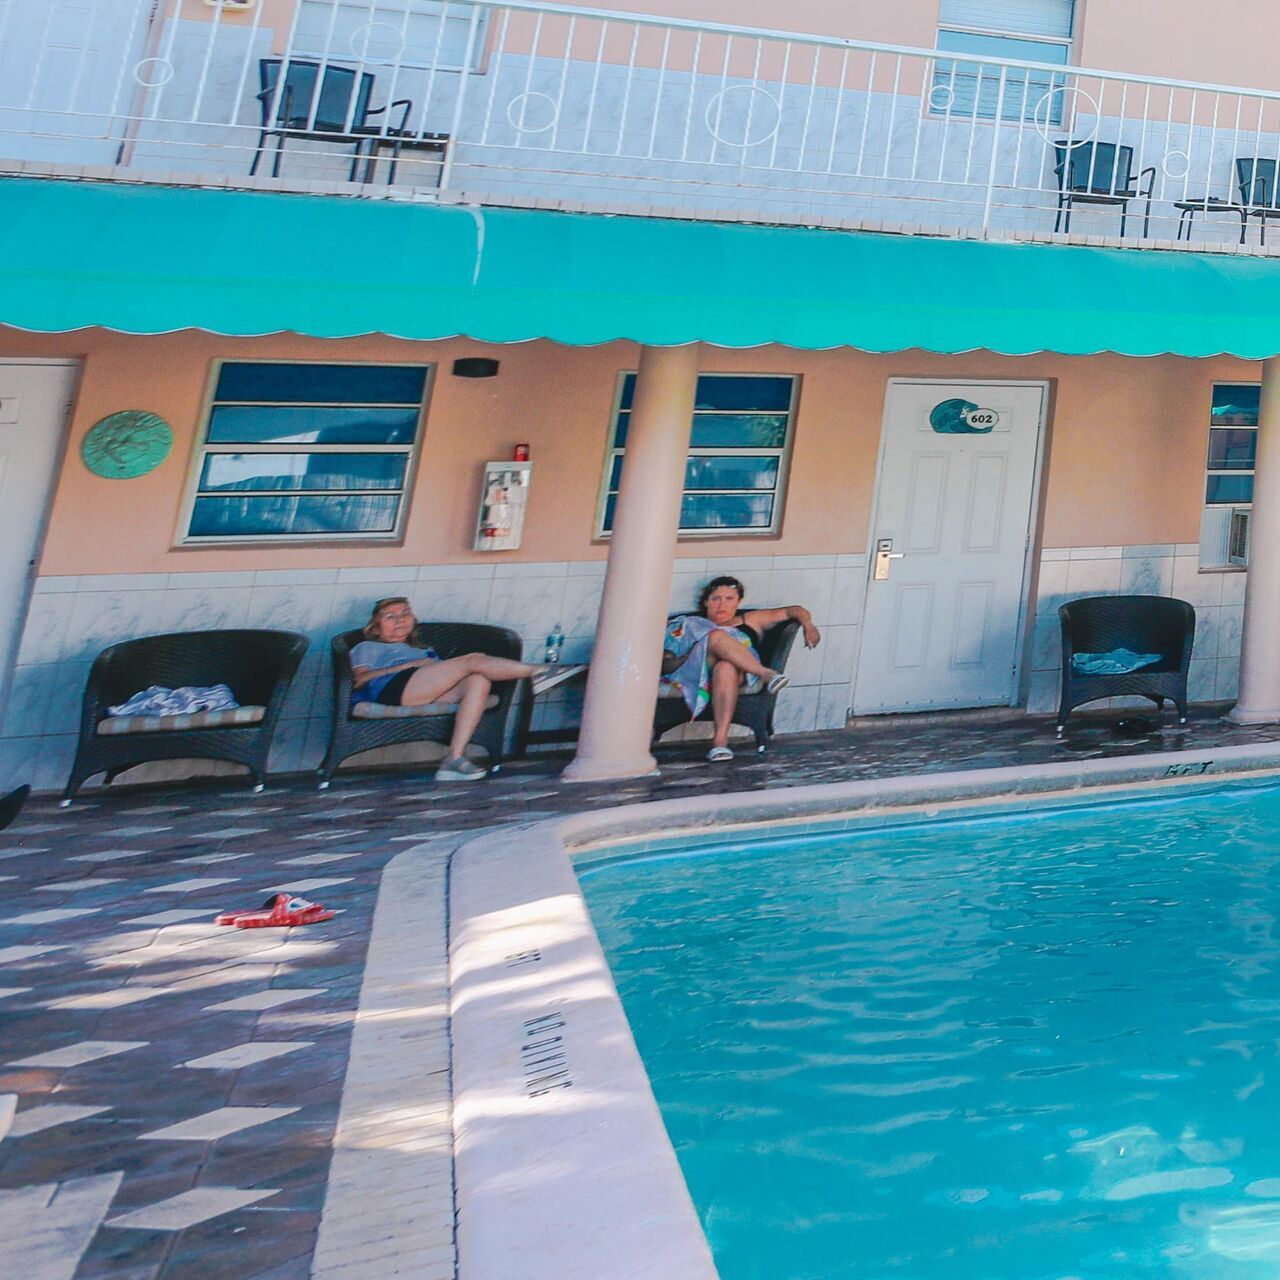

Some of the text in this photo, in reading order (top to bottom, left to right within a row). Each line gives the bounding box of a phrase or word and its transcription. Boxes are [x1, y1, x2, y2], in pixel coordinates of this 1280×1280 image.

[971, 414, 993, 423] 602
[520, 1011, 573, 1098] NO DIVING
